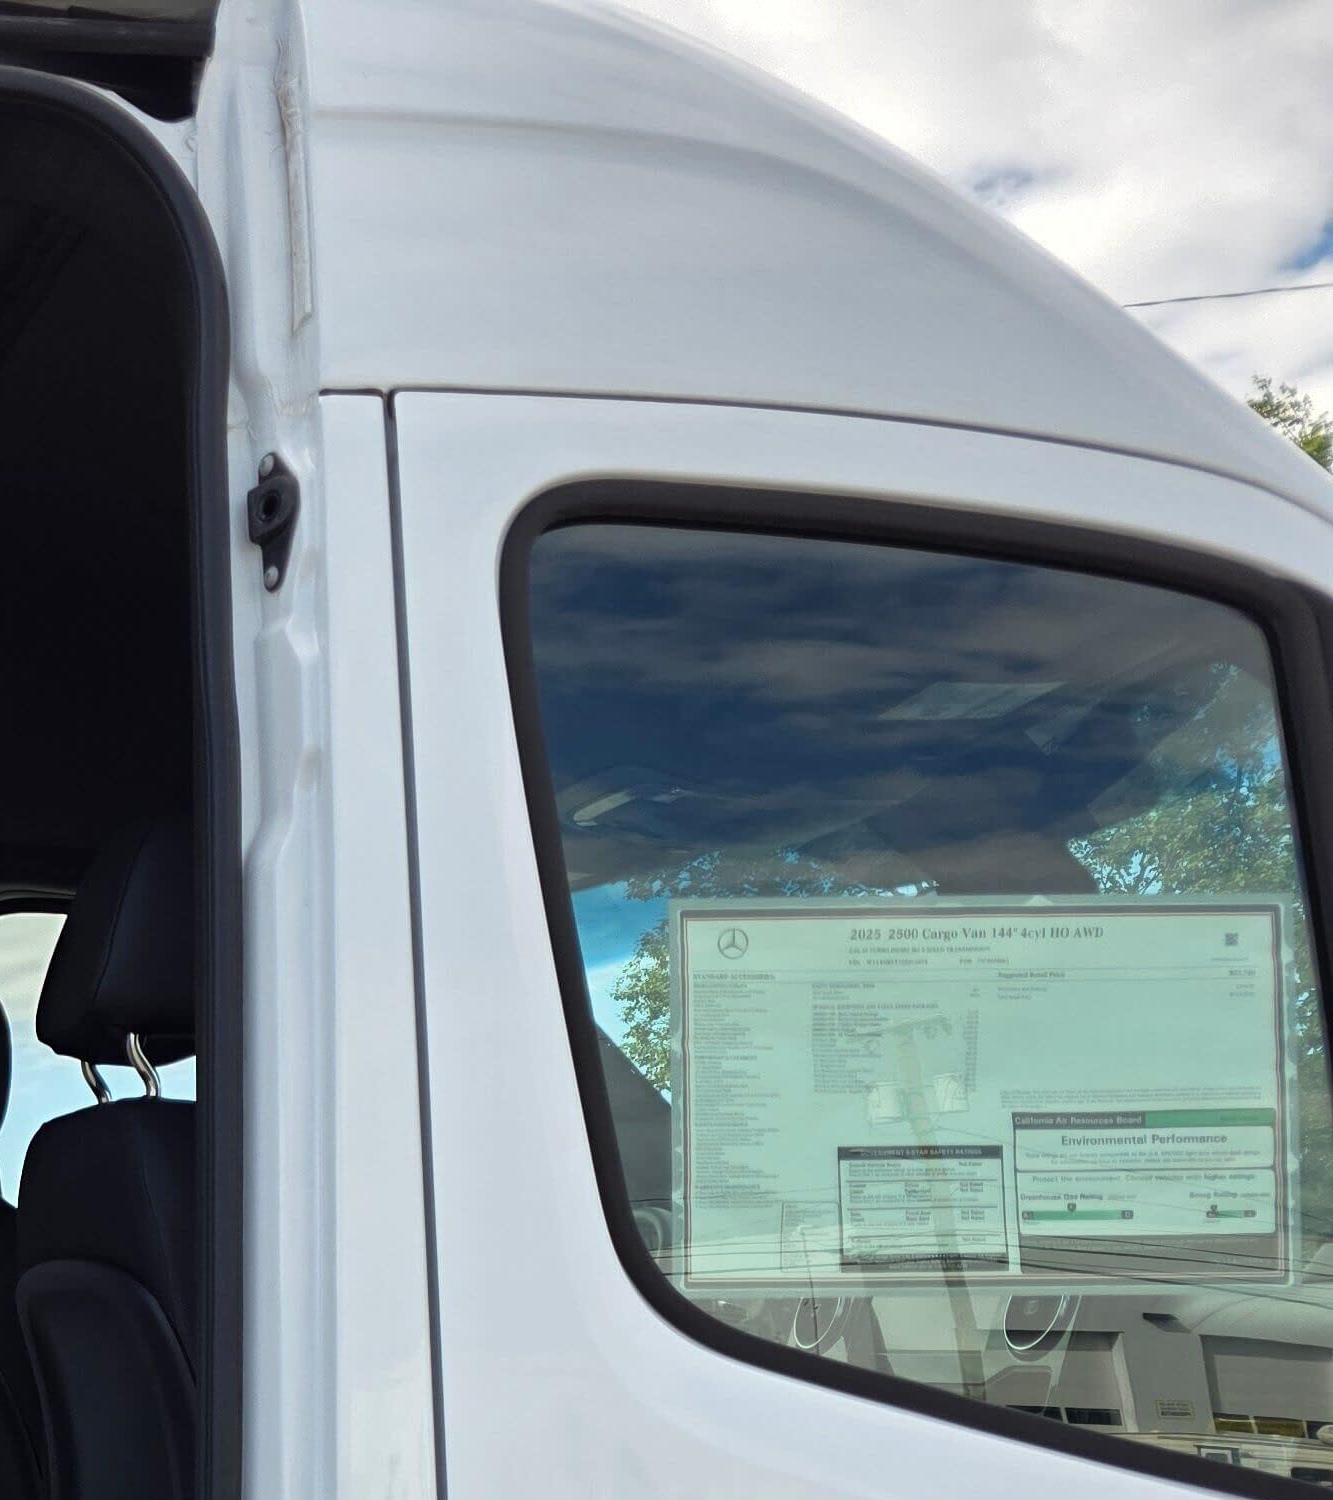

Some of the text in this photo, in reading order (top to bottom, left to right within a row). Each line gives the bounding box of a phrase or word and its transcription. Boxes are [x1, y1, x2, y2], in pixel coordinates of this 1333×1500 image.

[850, 926, 1104, 942] 2025 2500 Cargo Van 144" 4cyl HO AWD
[1014, 1116, 1142, 1125] California Air Resources Board
[1061, 1134, 1227, 1146] Environmental Performance
